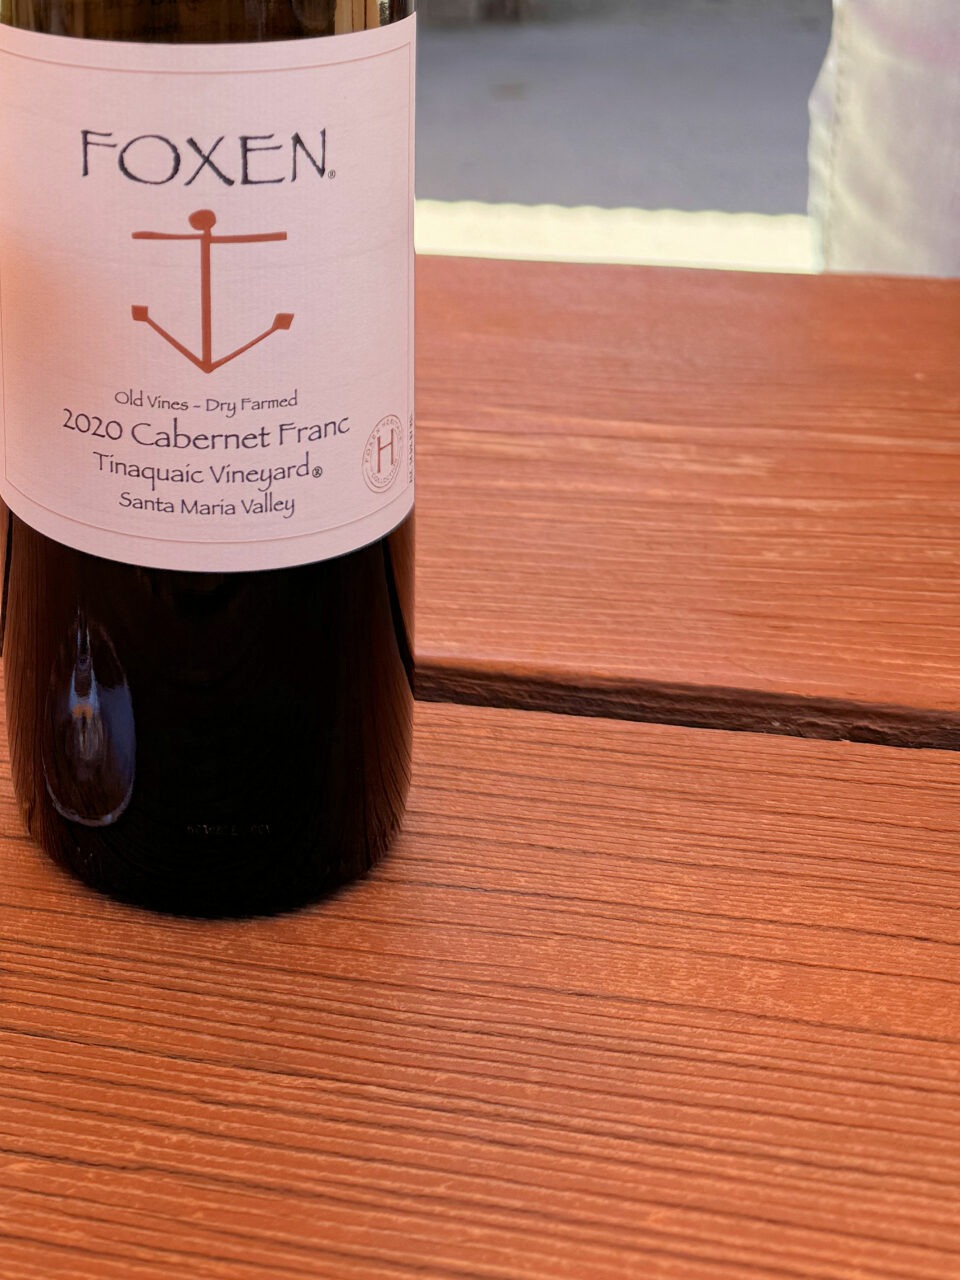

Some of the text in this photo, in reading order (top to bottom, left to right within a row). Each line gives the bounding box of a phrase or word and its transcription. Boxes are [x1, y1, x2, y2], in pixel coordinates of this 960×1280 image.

[114, 388, 143, 408] Old
[147, 394, 189, 411] Vines
[205, 398, 236, 418] Dry
[241, 388, 298, 410] Farmed
[63, 408, 123, 440] 2020
[131, 417, 271, 450] Cabernet
[279, 417, 350, 446] Franc
[92, 451, 204, 491] Tinaquaic
[119, 491, 295, 519] Santa Maria Valley
